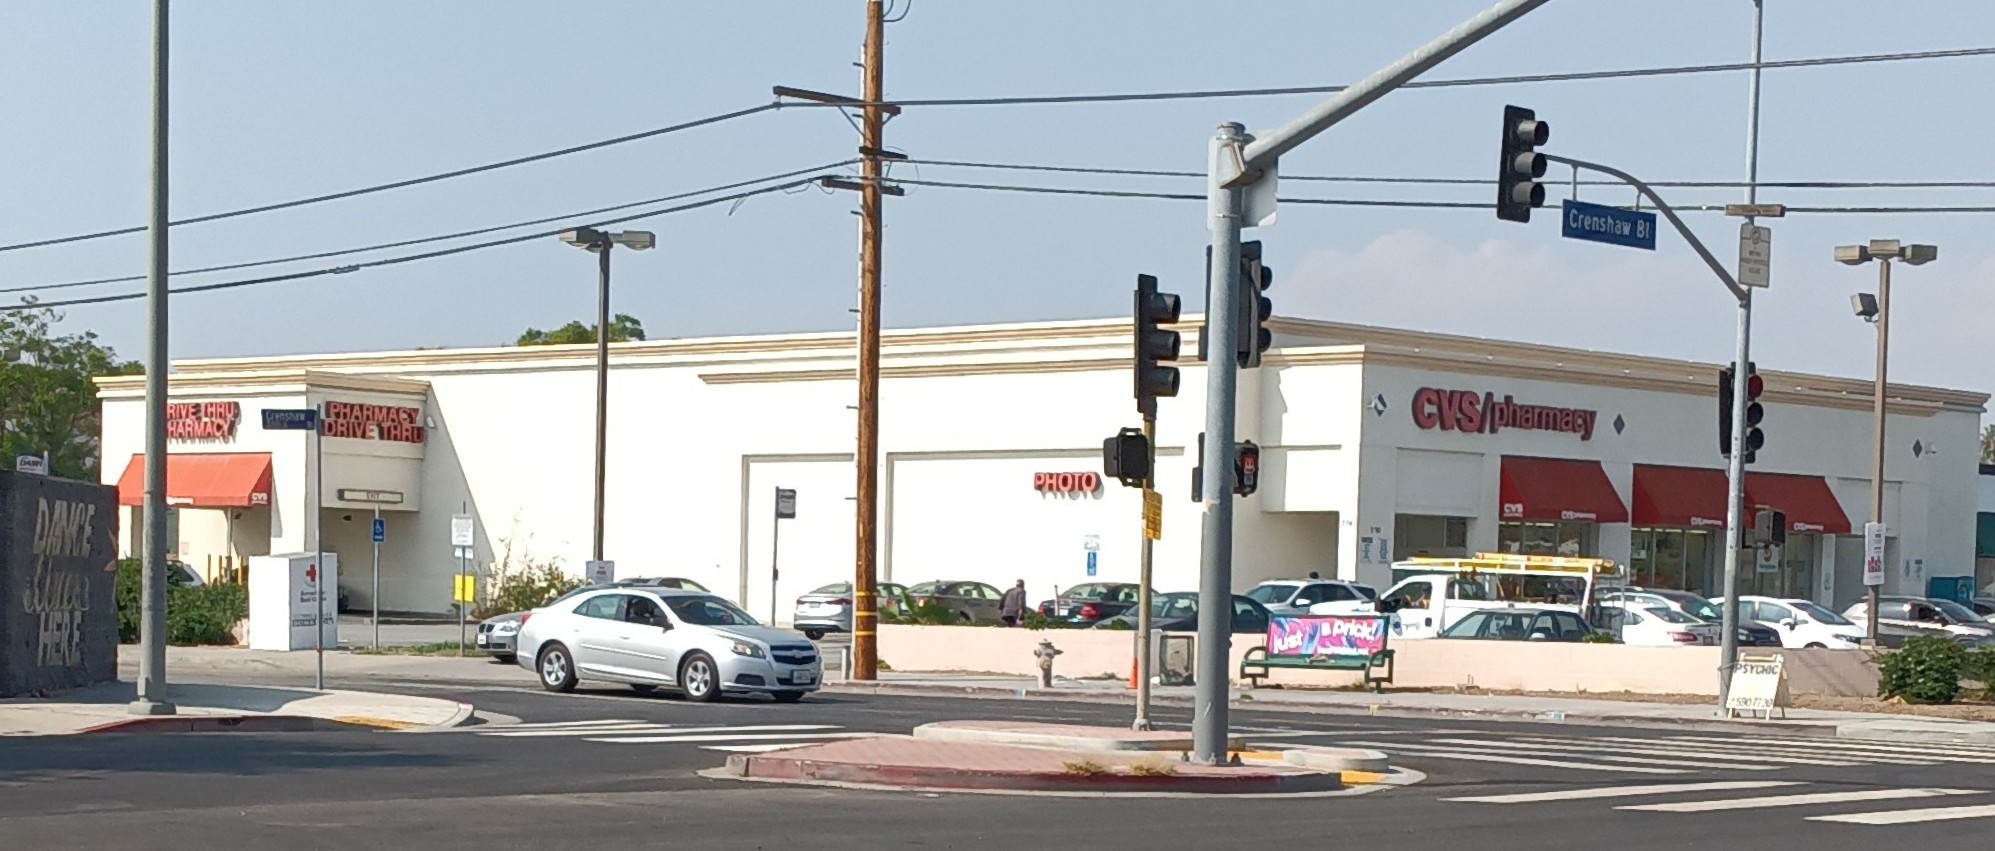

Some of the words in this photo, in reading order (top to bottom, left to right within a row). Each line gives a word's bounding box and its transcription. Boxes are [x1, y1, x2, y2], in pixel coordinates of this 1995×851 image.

[1569, 208, 1631, 236] Crenshaw
[1636, 219, 1650, 239] Bl
[167, 403, 198, 419] RIVE
[201, 402, 236, 418] THRU
[327, 401, 420, 425] PHARMACY
[1412, 386, 1597, 441] CVS/pharmacy
[167, 419, 232, 438] HARMACY
[323, 418, 375, 439] DRIVE
[380, 422, 425, 443] THRU
[1034, 472, 1099, 492] PHOTO
[33, 496, 96, 558] DANCE
[37, 611, 83, 667] HERE
[1734, 663, 1779, 675] PSYCHIC
